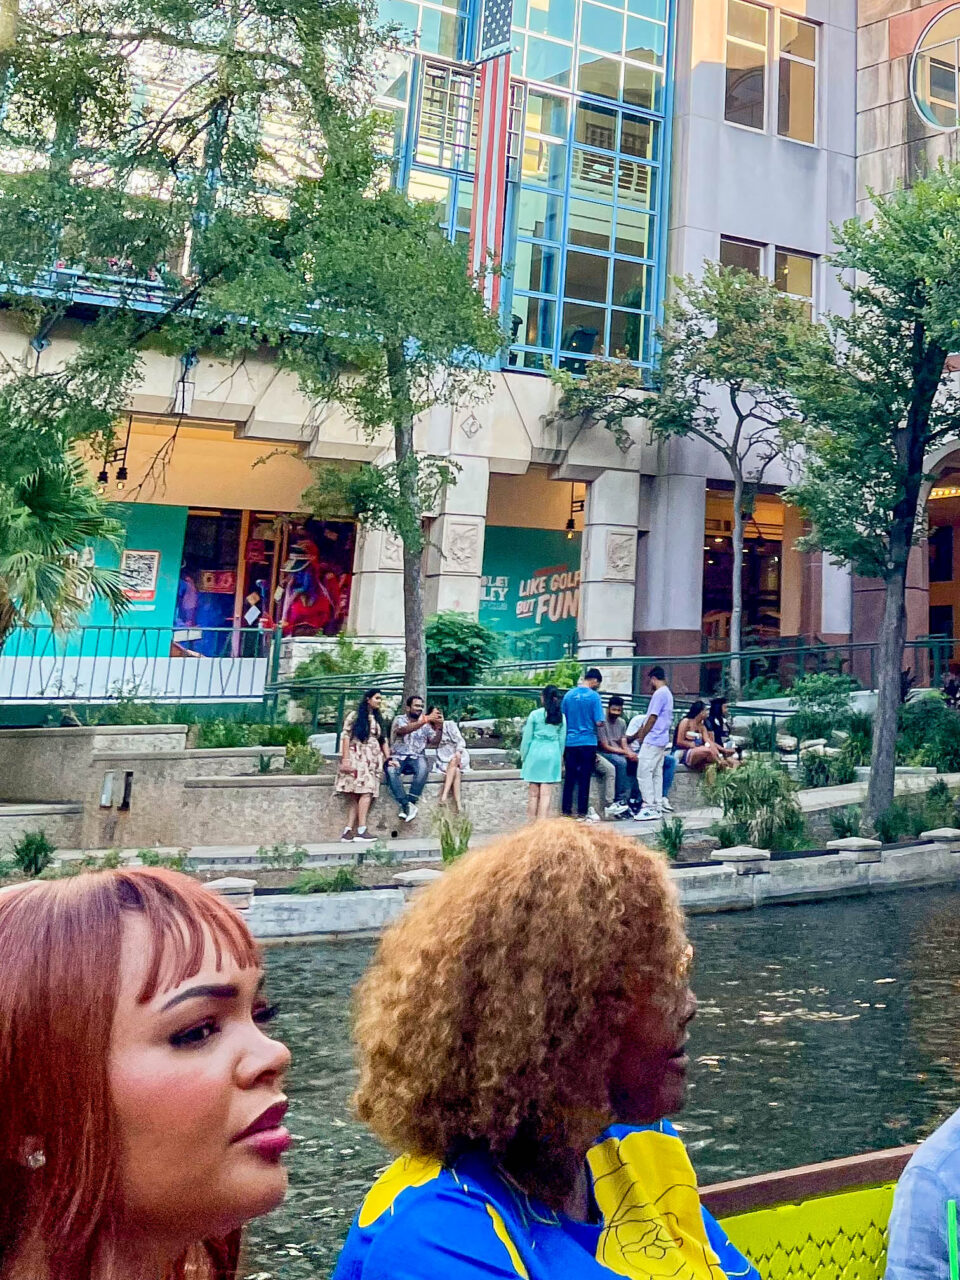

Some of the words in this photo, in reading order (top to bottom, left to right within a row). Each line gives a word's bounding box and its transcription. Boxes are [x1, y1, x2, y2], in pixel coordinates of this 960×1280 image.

[518, 576, 547, 597] LIKE
[516, 598, 536, 616] BUT
[535, 589, 579, 625] FUN
